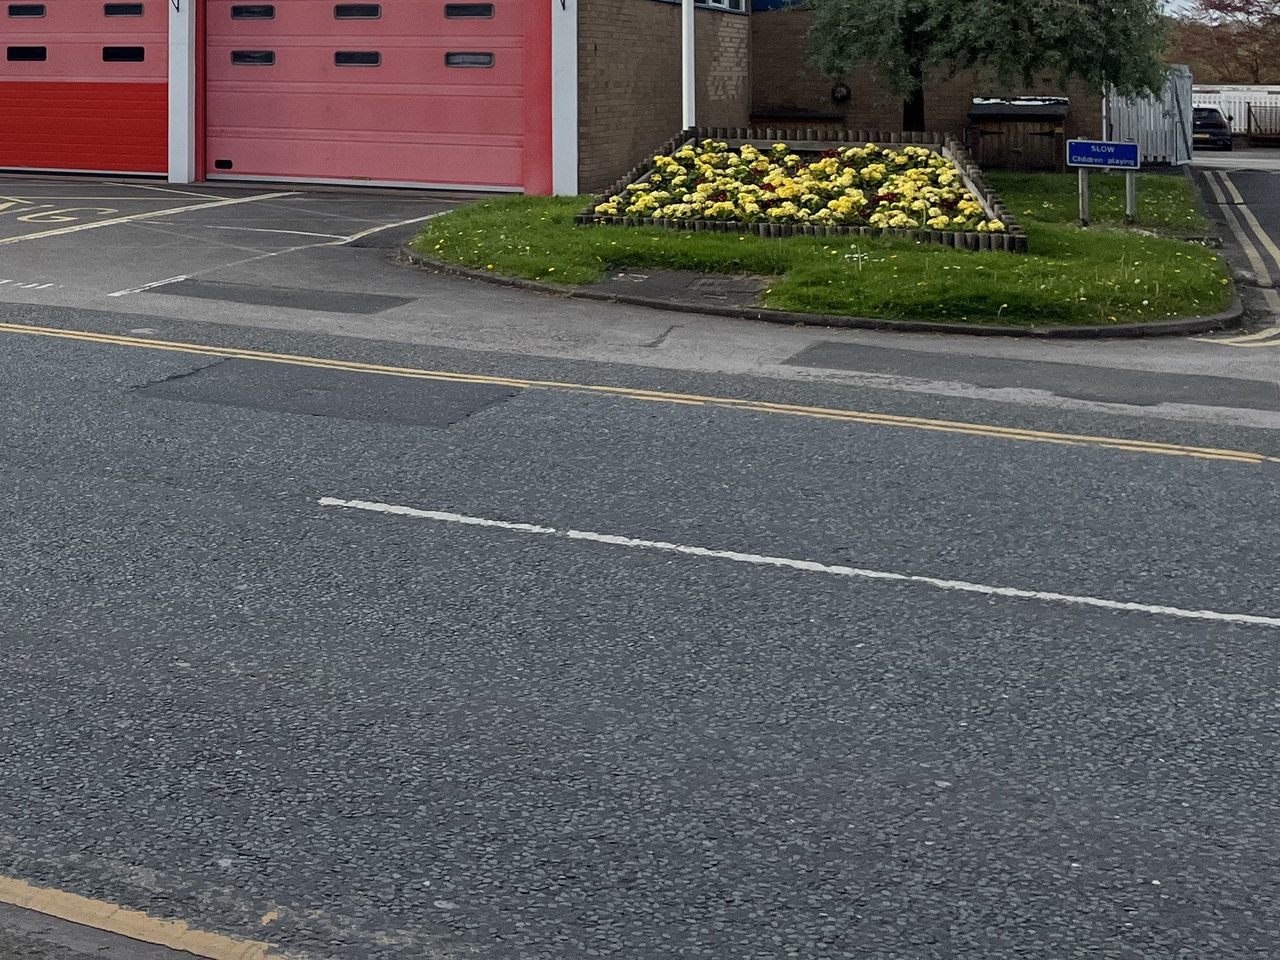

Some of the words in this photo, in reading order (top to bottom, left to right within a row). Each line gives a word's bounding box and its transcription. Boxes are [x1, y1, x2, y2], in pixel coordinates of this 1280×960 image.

[1091, 145, 1115, 153] SLOW
[1072, 155, 1104, 164] Children
[1107, 157, 1135, 166] playing
